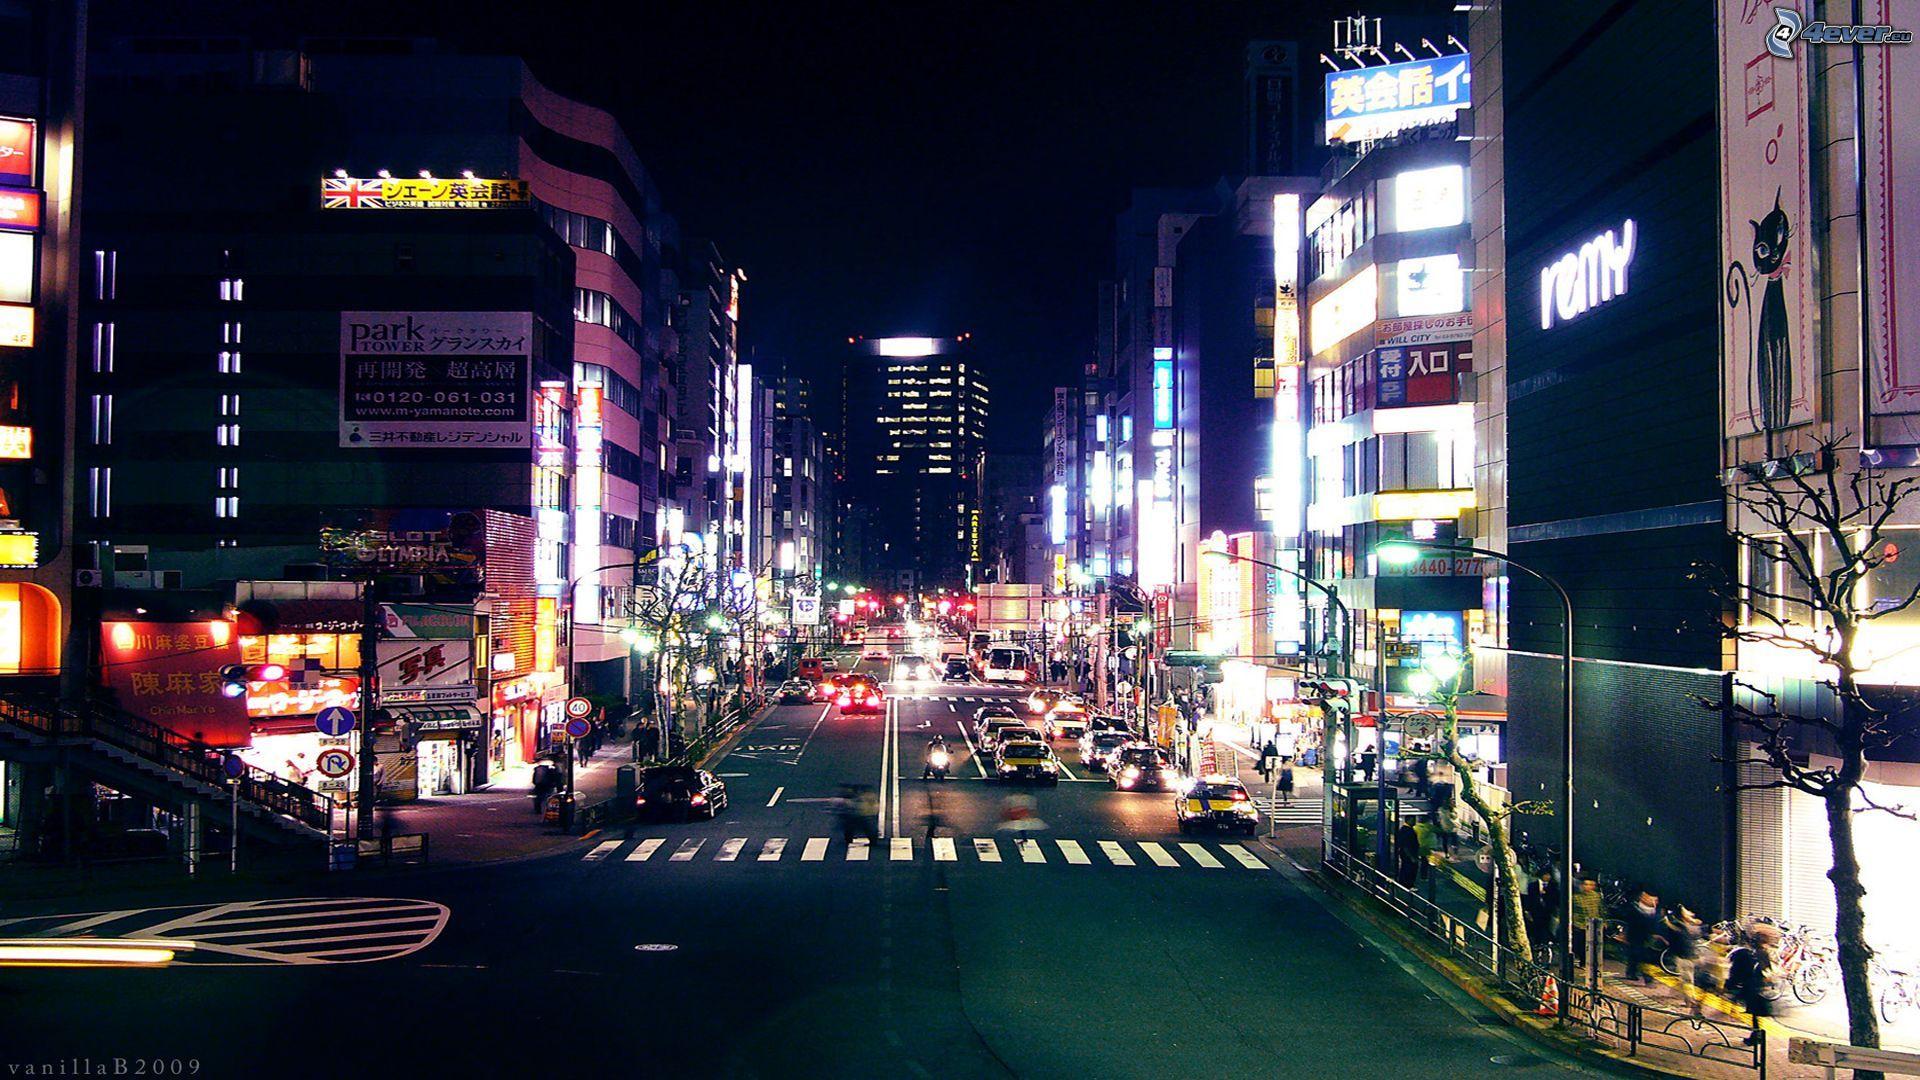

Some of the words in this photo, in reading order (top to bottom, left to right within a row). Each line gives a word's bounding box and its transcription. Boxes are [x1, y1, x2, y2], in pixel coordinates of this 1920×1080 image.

[1331, 60, 1471, 116] 英会話イ
[350, 316, 425, 352] park
[361, 342, 425, 352] TOWER
[431, 336, 526, 351] グランスカイ
[356, 361, 427, 380] 再開発
[447, 361, 516, 380] 超高層
[1408, 350, 1449, 376] 入口
[373, 391, 516, 403] 0120-061-031
[356, 406, 515, 417] www.m-yamanote.com
[369, 431, 524, 443] 三井不動産レジデンシャル
[971, 514, 979, 557] ARIETTA
[572, 703, 586, 712] 40
